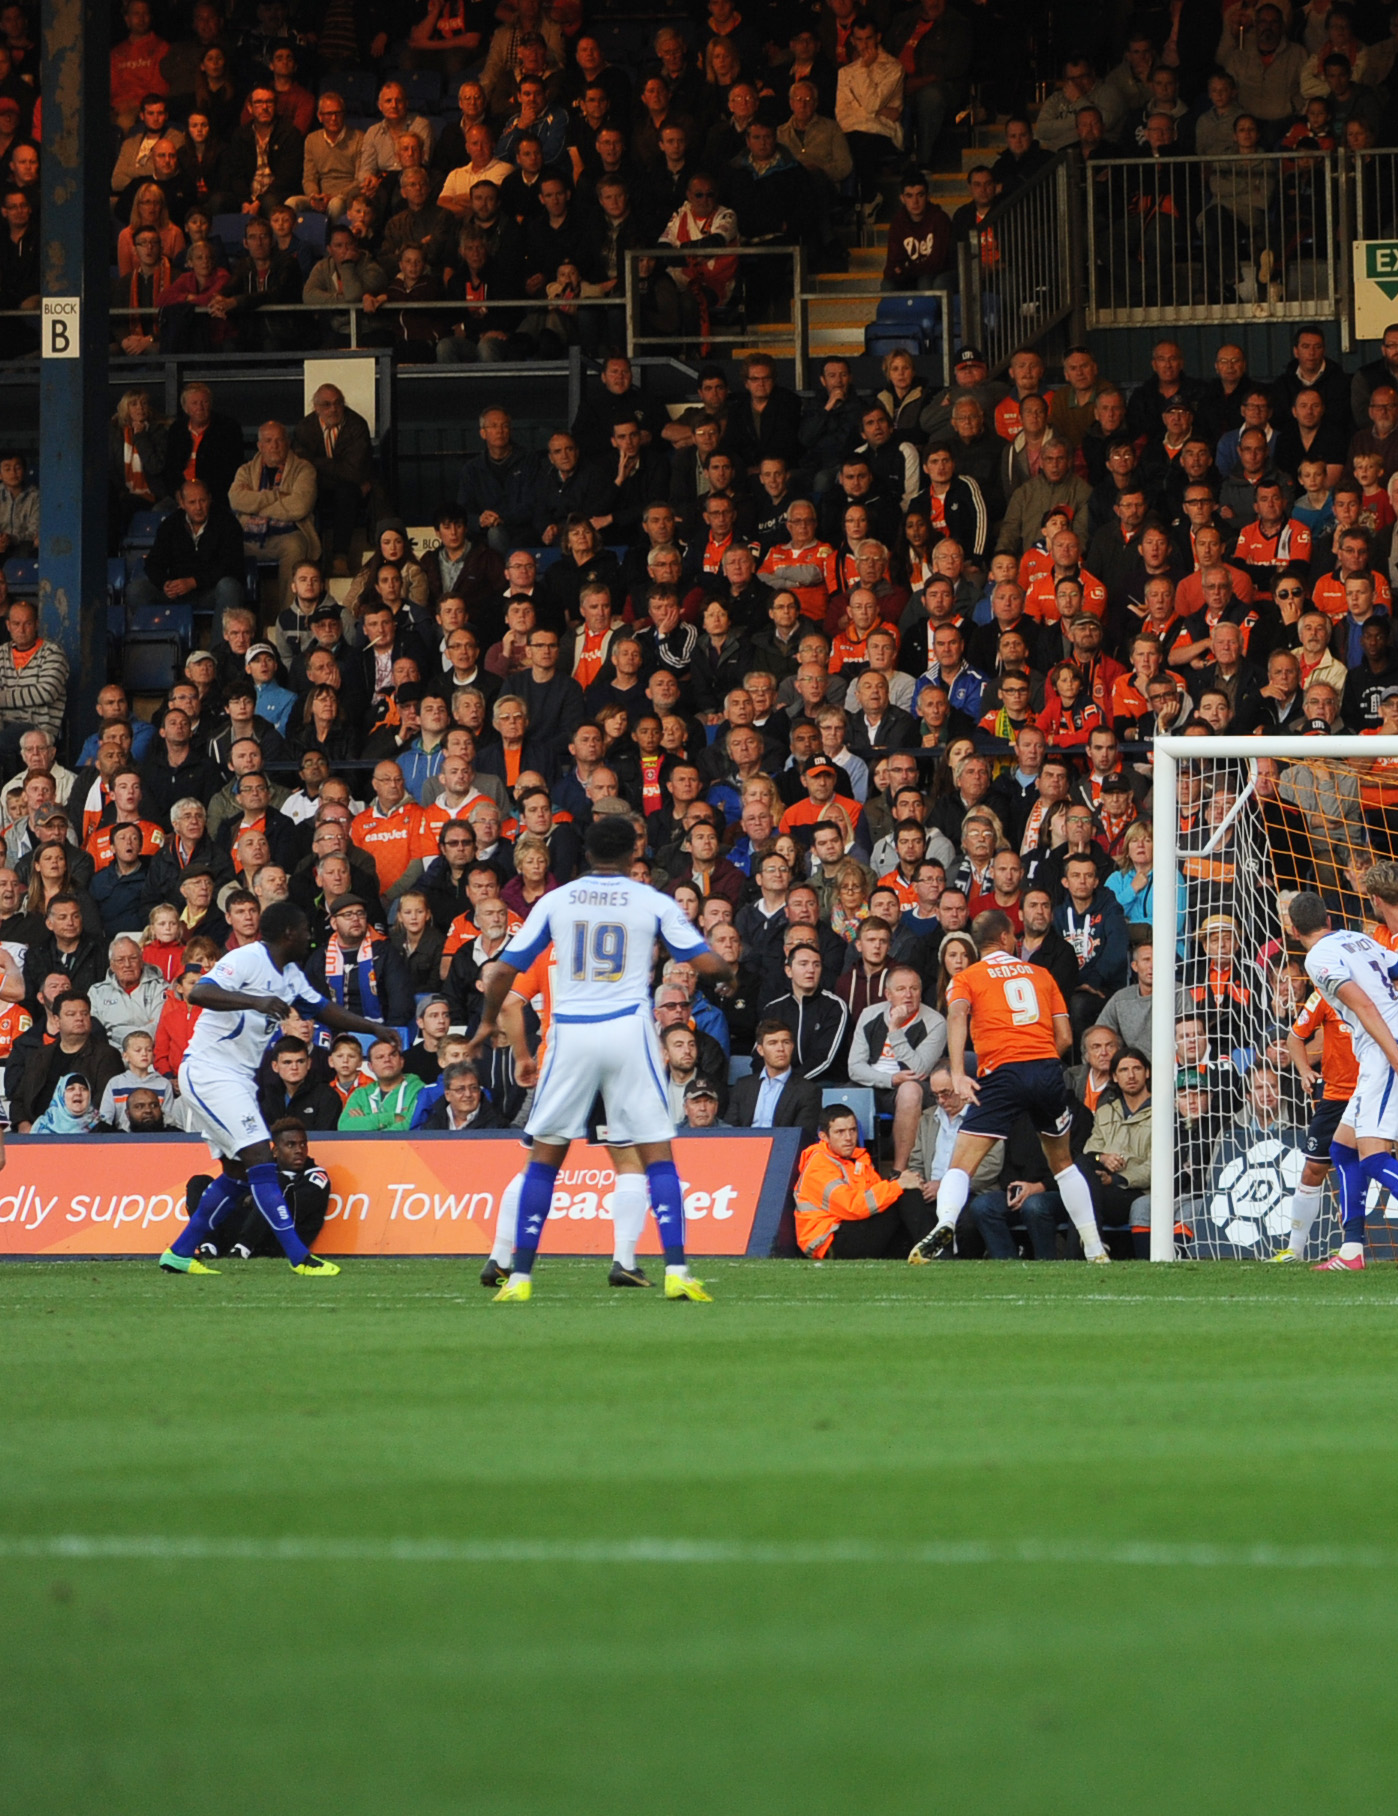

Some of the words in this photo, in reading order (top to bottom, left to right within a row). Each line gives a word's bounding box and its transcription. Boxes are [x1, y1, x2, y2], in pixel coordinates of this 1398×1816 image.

[45, 303, 78, 315] BLOCK
[52, 319, 71, 353] B
[422, 539, 441, 550] BLO
[365, 829, 408, 842] easyJet
[569, 889, 630, 907] SOARES
[571, 920, 628, 982] 19
[987, 963, 1035, 979] BENSON
[1003, 977, 1040, 1026] 9
[555, 1169, 619, 1188] europ
[66, 1192, 189, 1230] suppo
[324, 1192, 371, 1221] on
[386, 1184, 492, 1221] Town
[547, 1182, 738, 1220] easet
